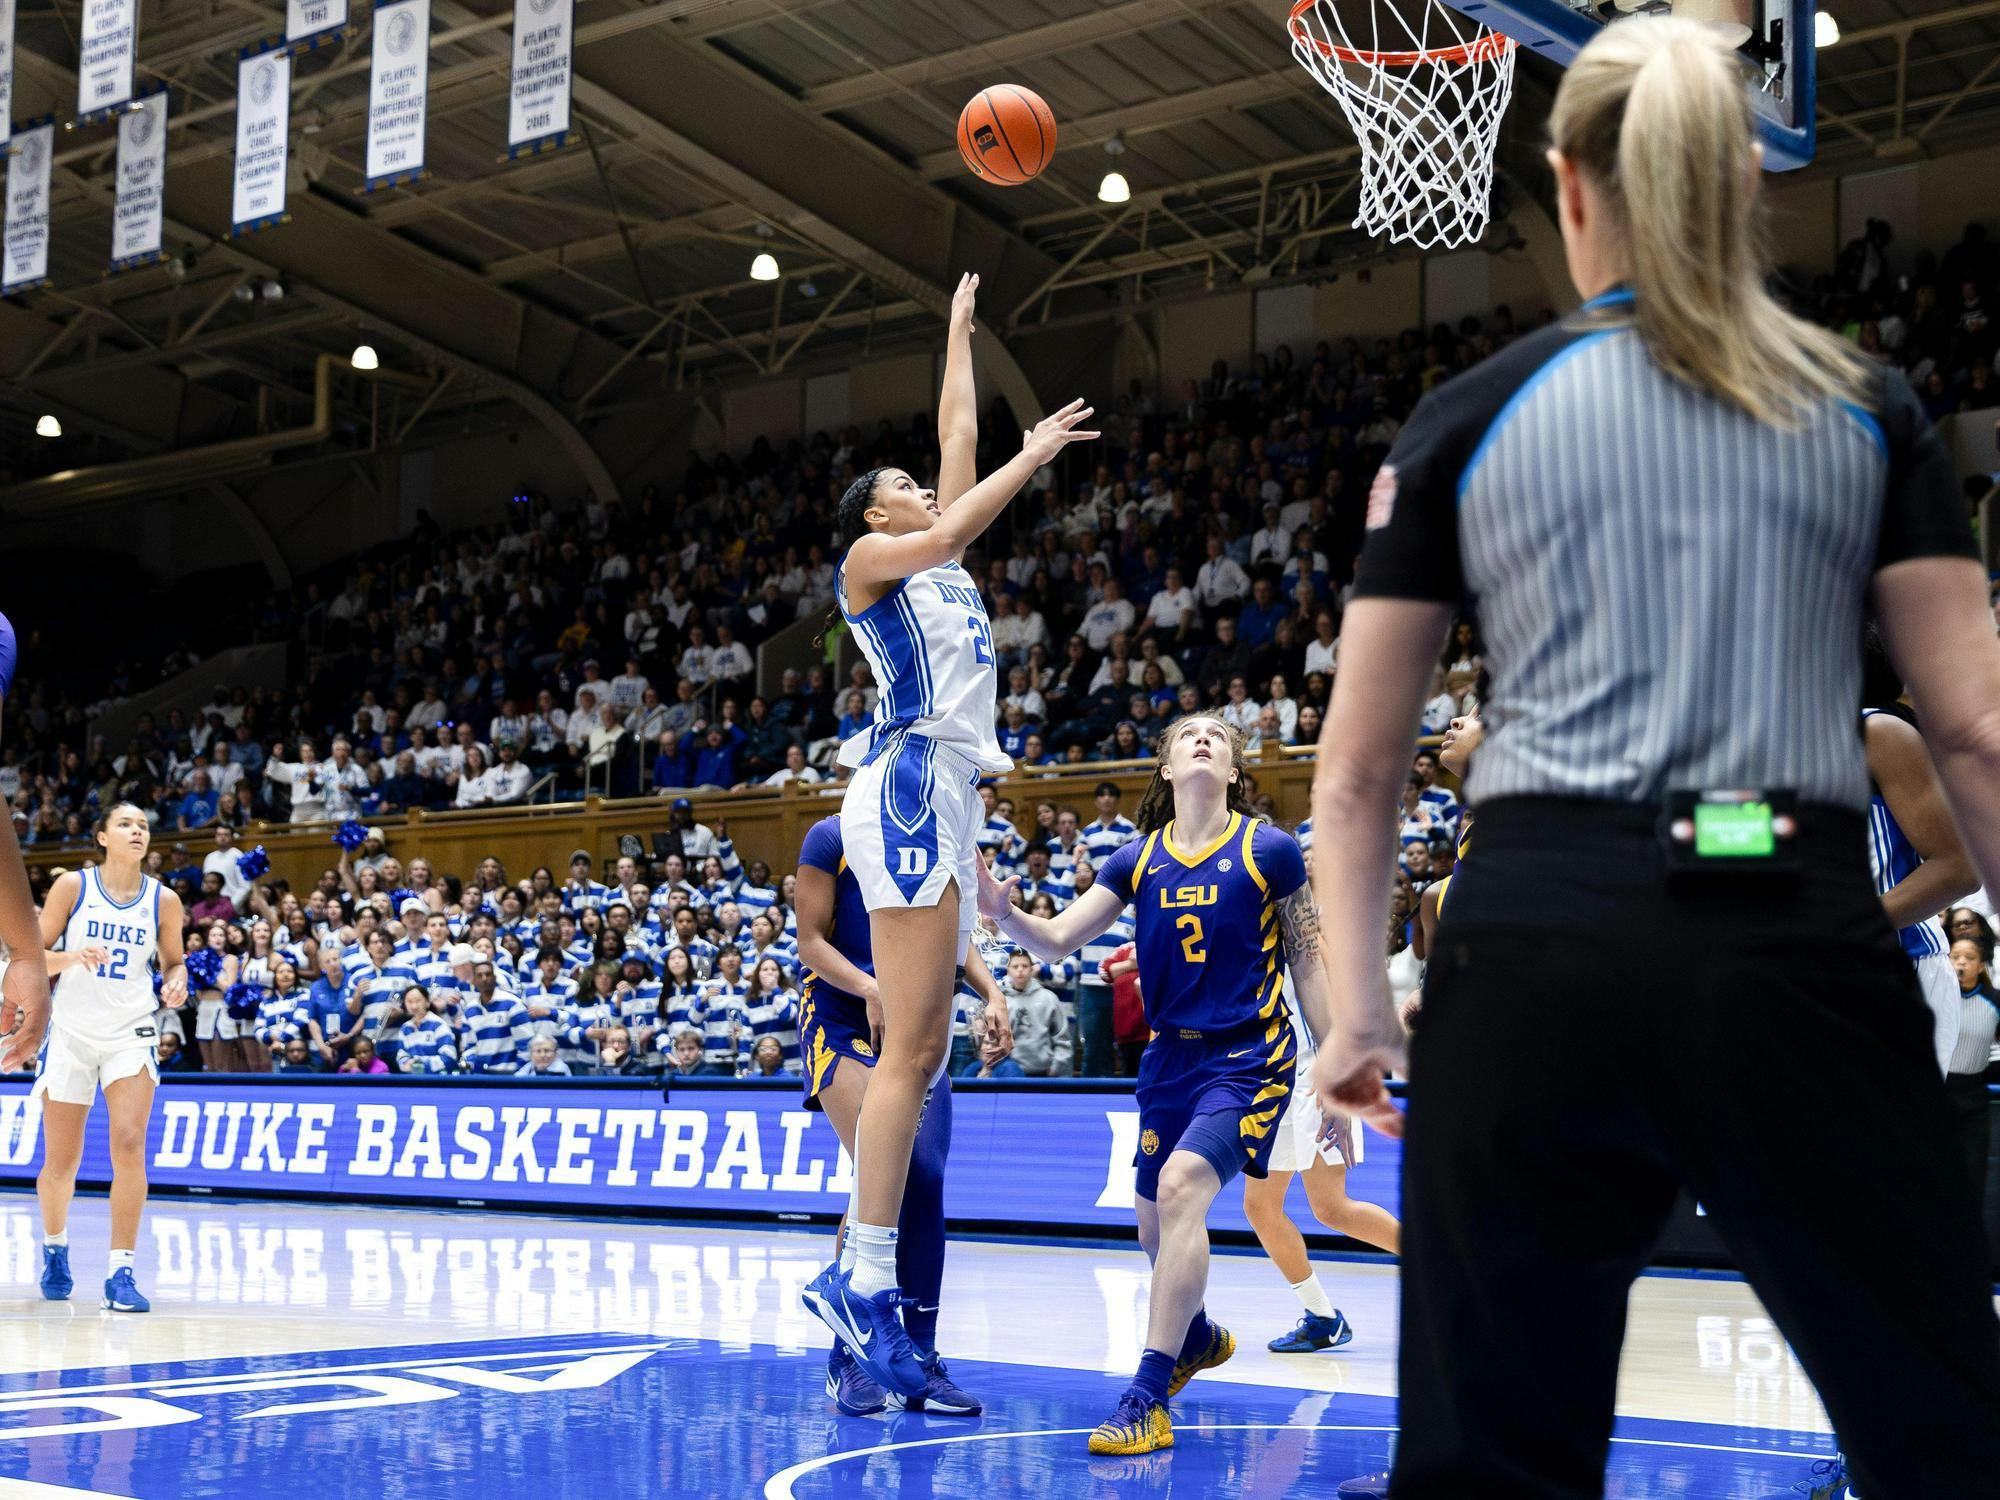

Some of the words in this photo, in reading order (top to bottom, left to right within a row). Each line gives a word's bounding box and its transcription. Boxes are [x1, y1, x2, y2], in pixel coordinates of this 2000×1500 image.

[522, 23, 562, 47] ATLANTIC
[527, 41, 556, 63] COAST
[379, 63, 418, 85] ATLANTIC
[512, 54, 568, 82] CONFERENCE
[383, 82, 411, 99] COAST
[514, 71, 566, 98] CHAMPIONS
[372, 95, 423, 119] CONFERENCE
[373, 110, 421, 135] CHAMPIONS
[932, 581, 986, 614] DUK
[968, 616, 995, 670] 21
[896, 847, 928, 875] D
[1160, 884, 1218, 909] LSU
[86, 920, 147, 946] DUKE
[1176, 913, 1207, 963] 2
[153, 1100, 336, 1175] DUKE
